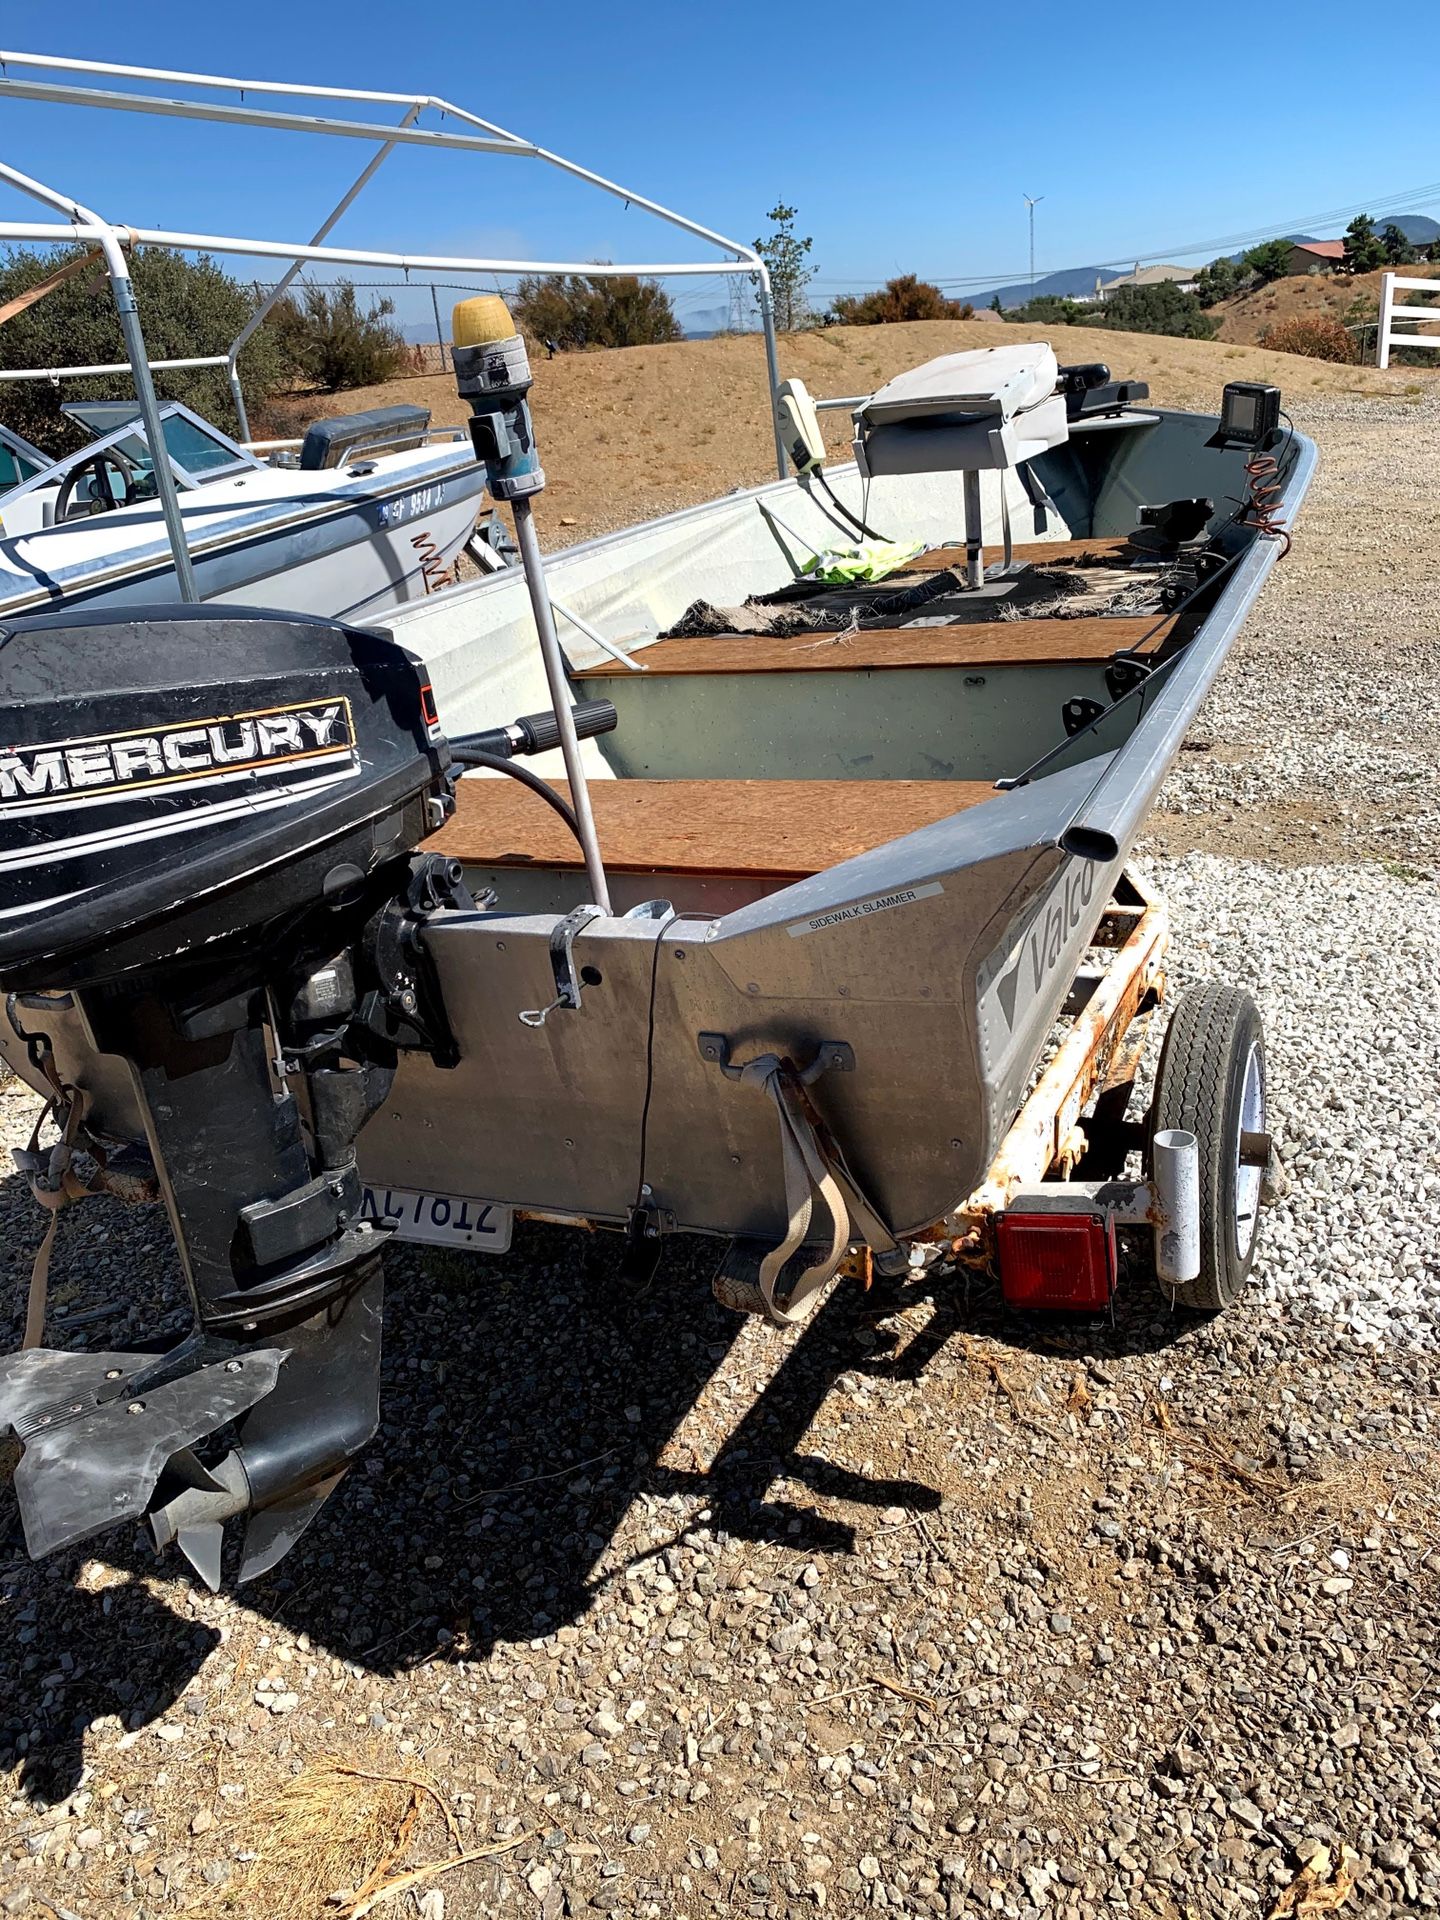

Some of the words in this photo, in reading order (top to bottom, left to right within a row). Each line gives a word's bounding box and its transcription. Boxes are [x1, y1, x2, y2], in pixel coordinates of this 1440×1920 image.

[0, 707, 340, 796] MERCURY
[809, 905, 862, 929] SIDEWALK
[862, 891, 916, 913] SLAMMER
[1031, 859, 1094, 994] Valco
